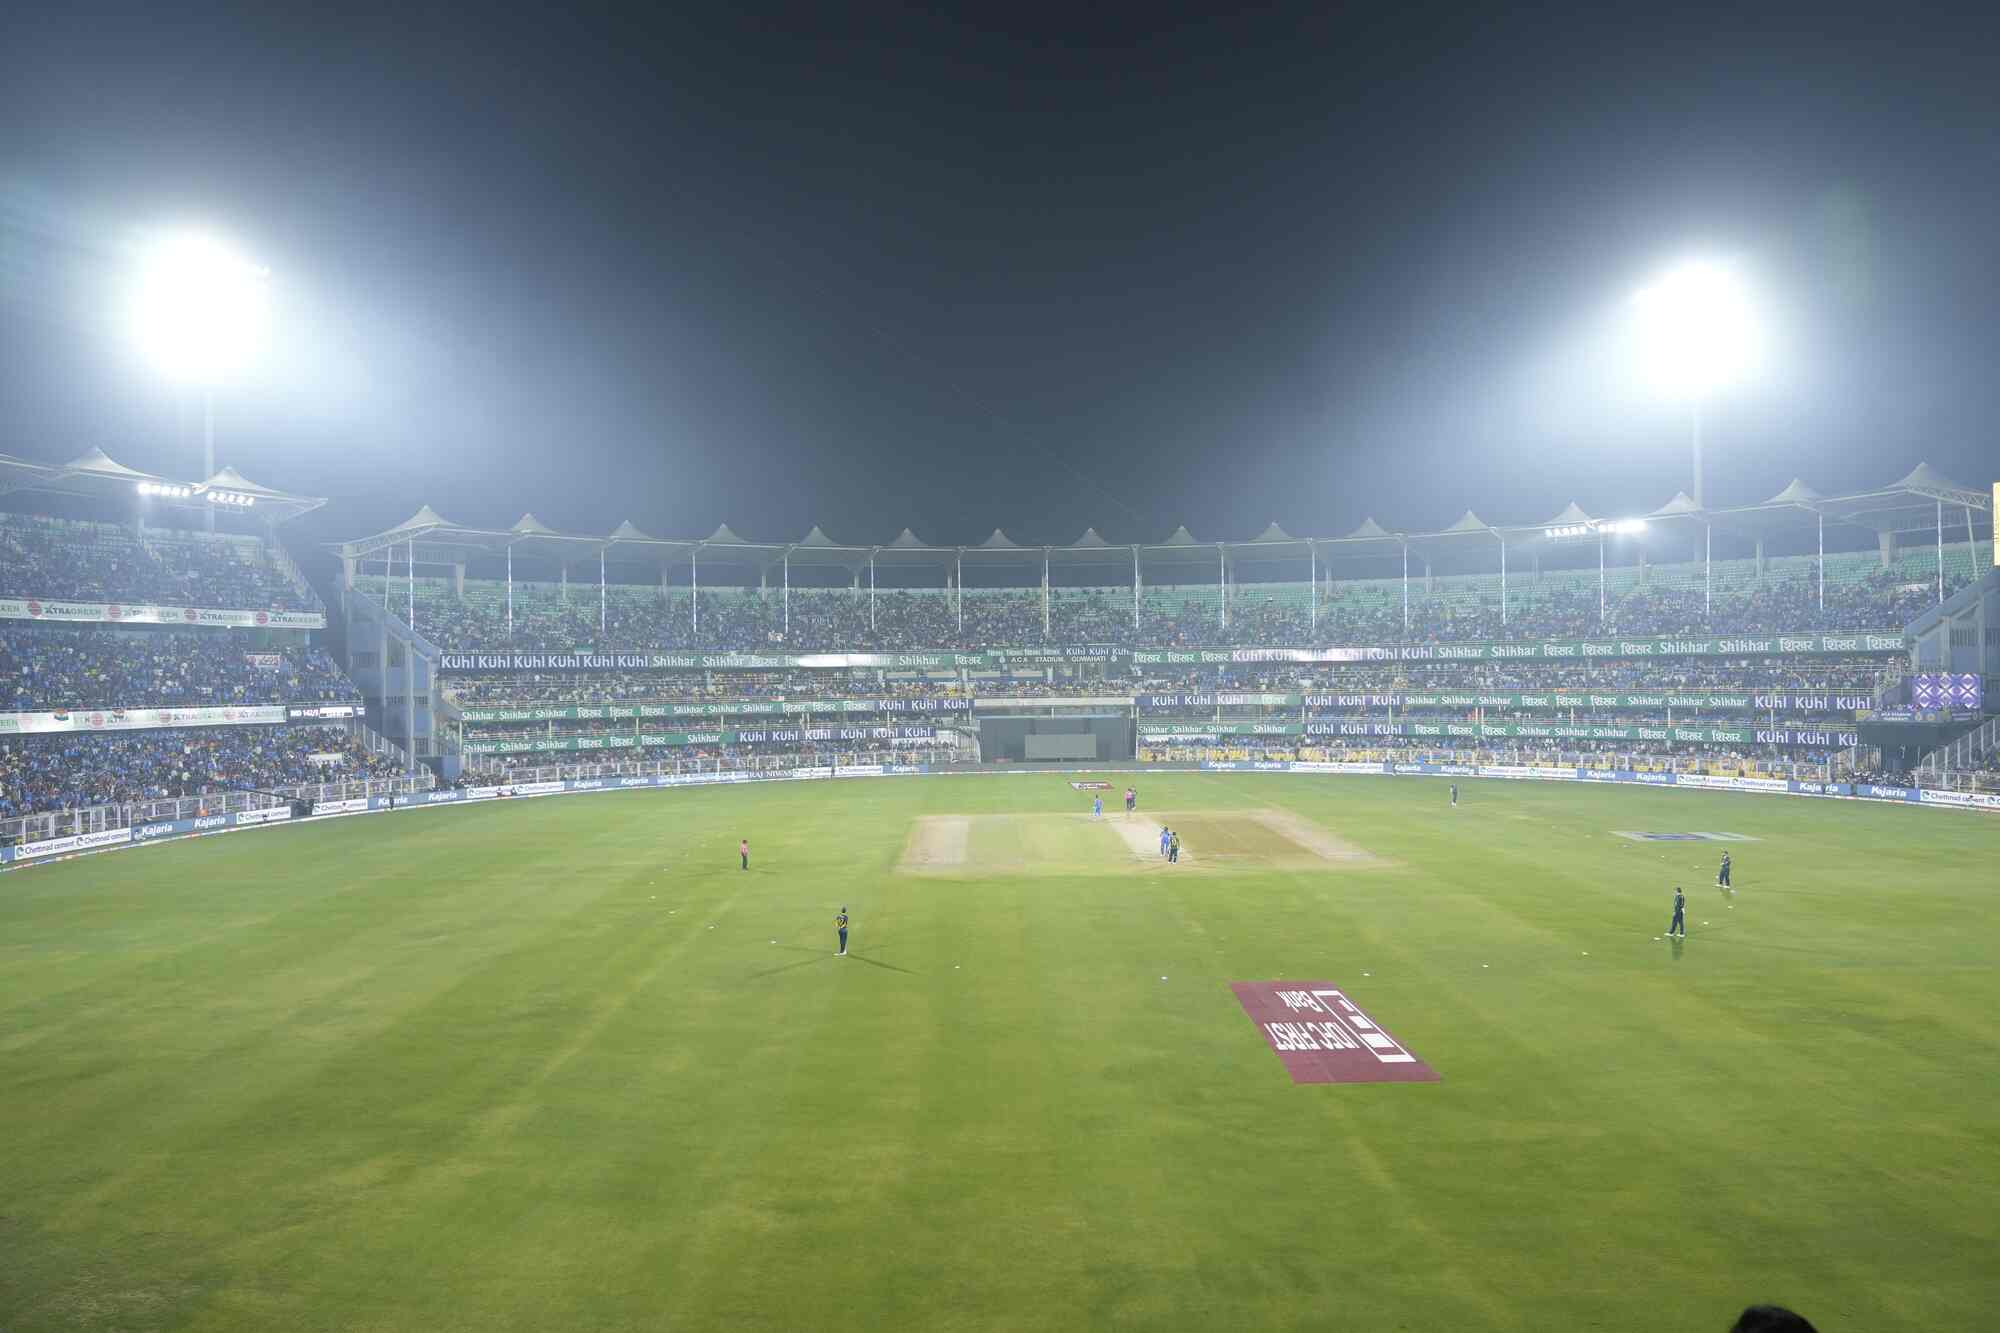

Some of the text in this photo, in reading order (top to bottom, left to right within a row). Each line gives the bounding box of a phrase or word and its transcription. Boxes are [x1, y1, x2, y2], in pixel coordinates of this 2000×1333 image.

[1438, 646, 1536, 658] Shikhar Shikhar
[1660, 640, 1771, 654] Shikhar Shikhar
[1872, 786, 1906, 798] Kajaria
[195, 816, 226, 829] Kajaria
[142, 824, 172, 836] Kajaria
[1276, 991, 1323, 1012] Bank
[1264, 1022, 1360, 1050] IDFC FIRST
